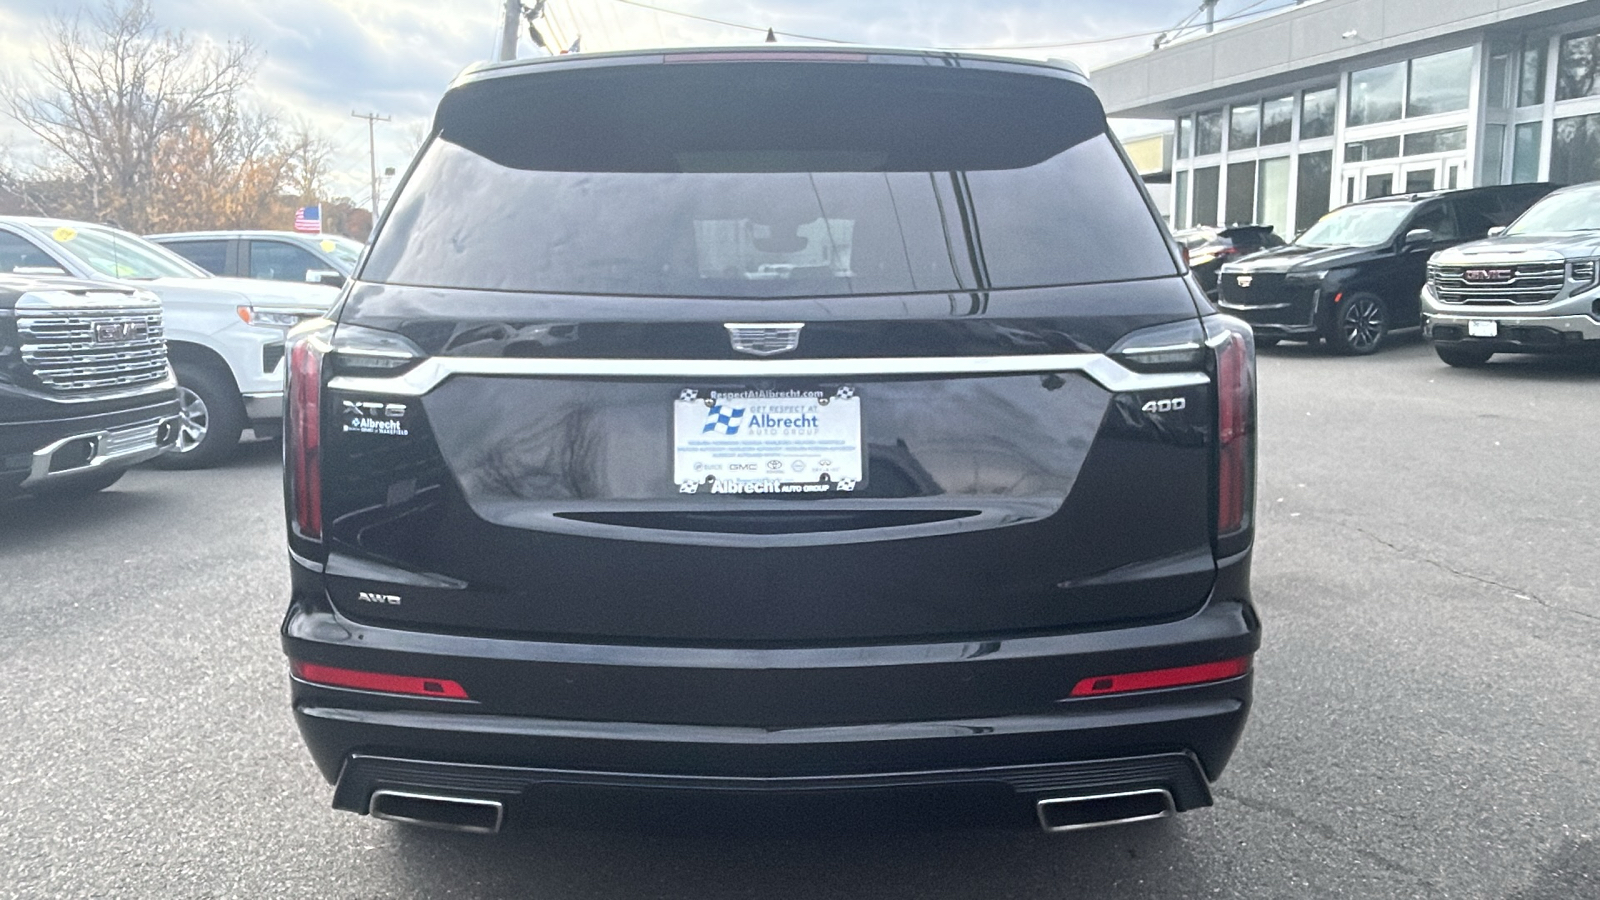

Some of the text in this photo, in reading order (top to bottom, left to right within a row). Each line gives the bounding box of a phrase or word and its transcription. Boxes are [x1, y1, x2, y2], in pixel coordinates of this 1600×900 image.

[1465, 269, 1511, 279] GMC
[710, 389, 824, 400] RespectAtAlbrecht.com
[750, 405, 818, 413] GET RESPECT AT
[1141, 397, 1186, 413] 400
[360, 417, 401, 430] Albrecht
[748, 413, 819, 428] Albrecht
[729, 463, 758, 471] GMC
[711, 478, 780, 494] Albrecht
[781, 485, 802, 493] AUTO
[803, 484, 830, 492] GROUP
